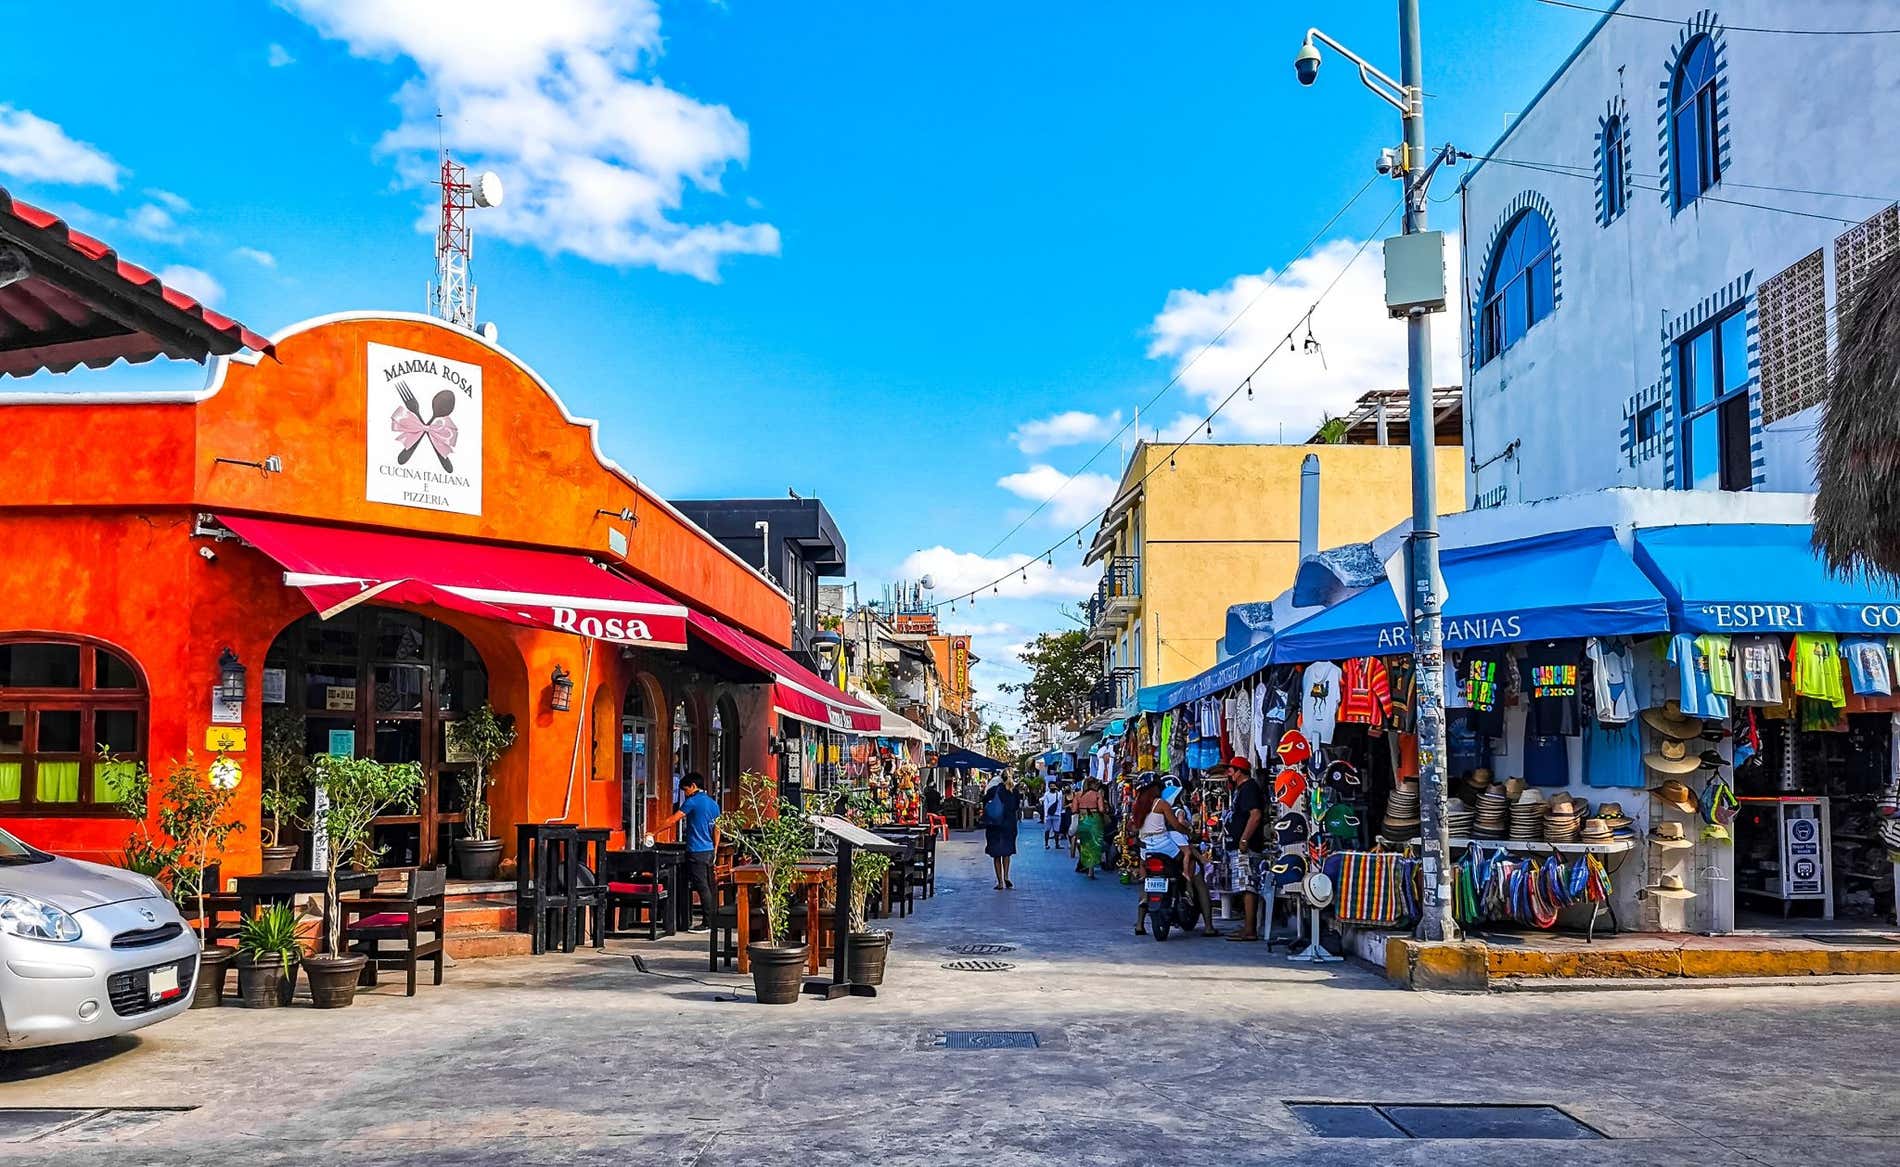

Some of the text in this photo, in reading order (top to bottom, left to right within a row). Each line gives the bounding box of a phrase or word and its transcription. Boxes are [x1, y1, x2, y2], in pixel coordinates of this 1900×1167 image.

[383, 359, 472, 399] MAMMA ROSA
[379, 464, 470, 488] CUCINA ITALIANA
[423, 482, 429, 492] E
[403, 491, 449, 506] PIZZERIA
[552, 606, 653, 640] Rosa
[1861, 605, 1900, 627] GO
